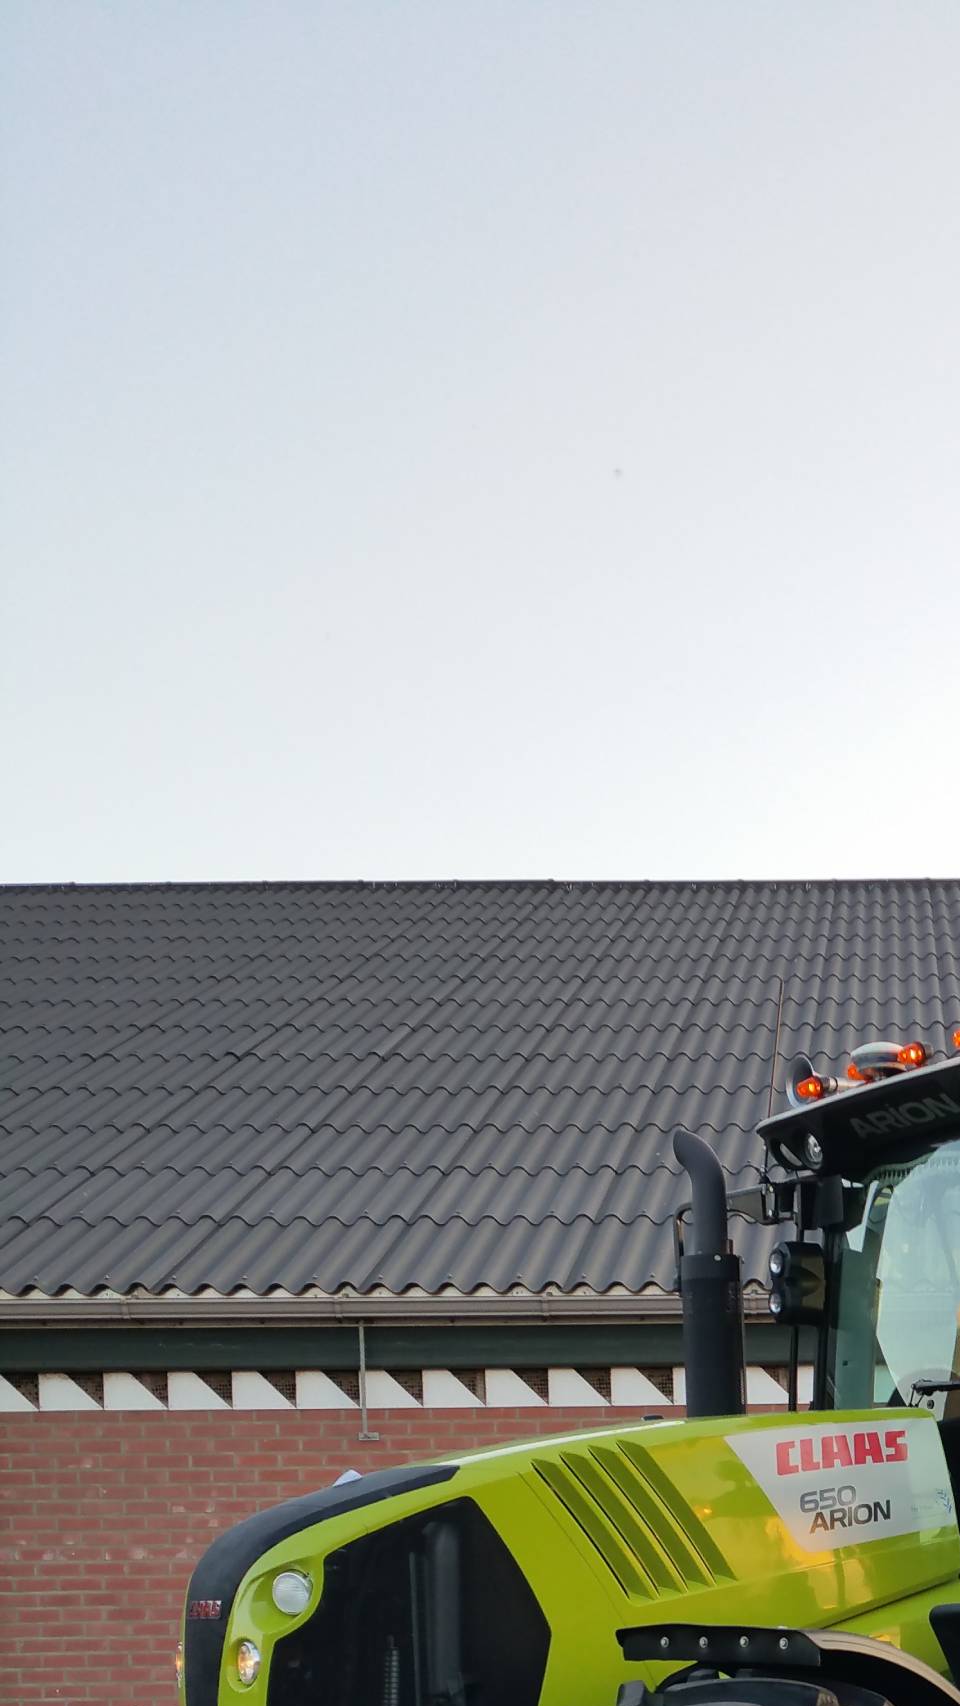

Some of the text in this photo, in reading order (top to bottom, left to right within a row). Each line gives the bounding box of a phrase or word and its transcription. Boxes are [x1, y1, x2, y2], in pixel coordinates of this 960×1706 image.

[776, 1430, 908, 1476] CLAAS
[799, 1485, 857, 1514] 650
[809, 1499, 891, 1534] ARION
